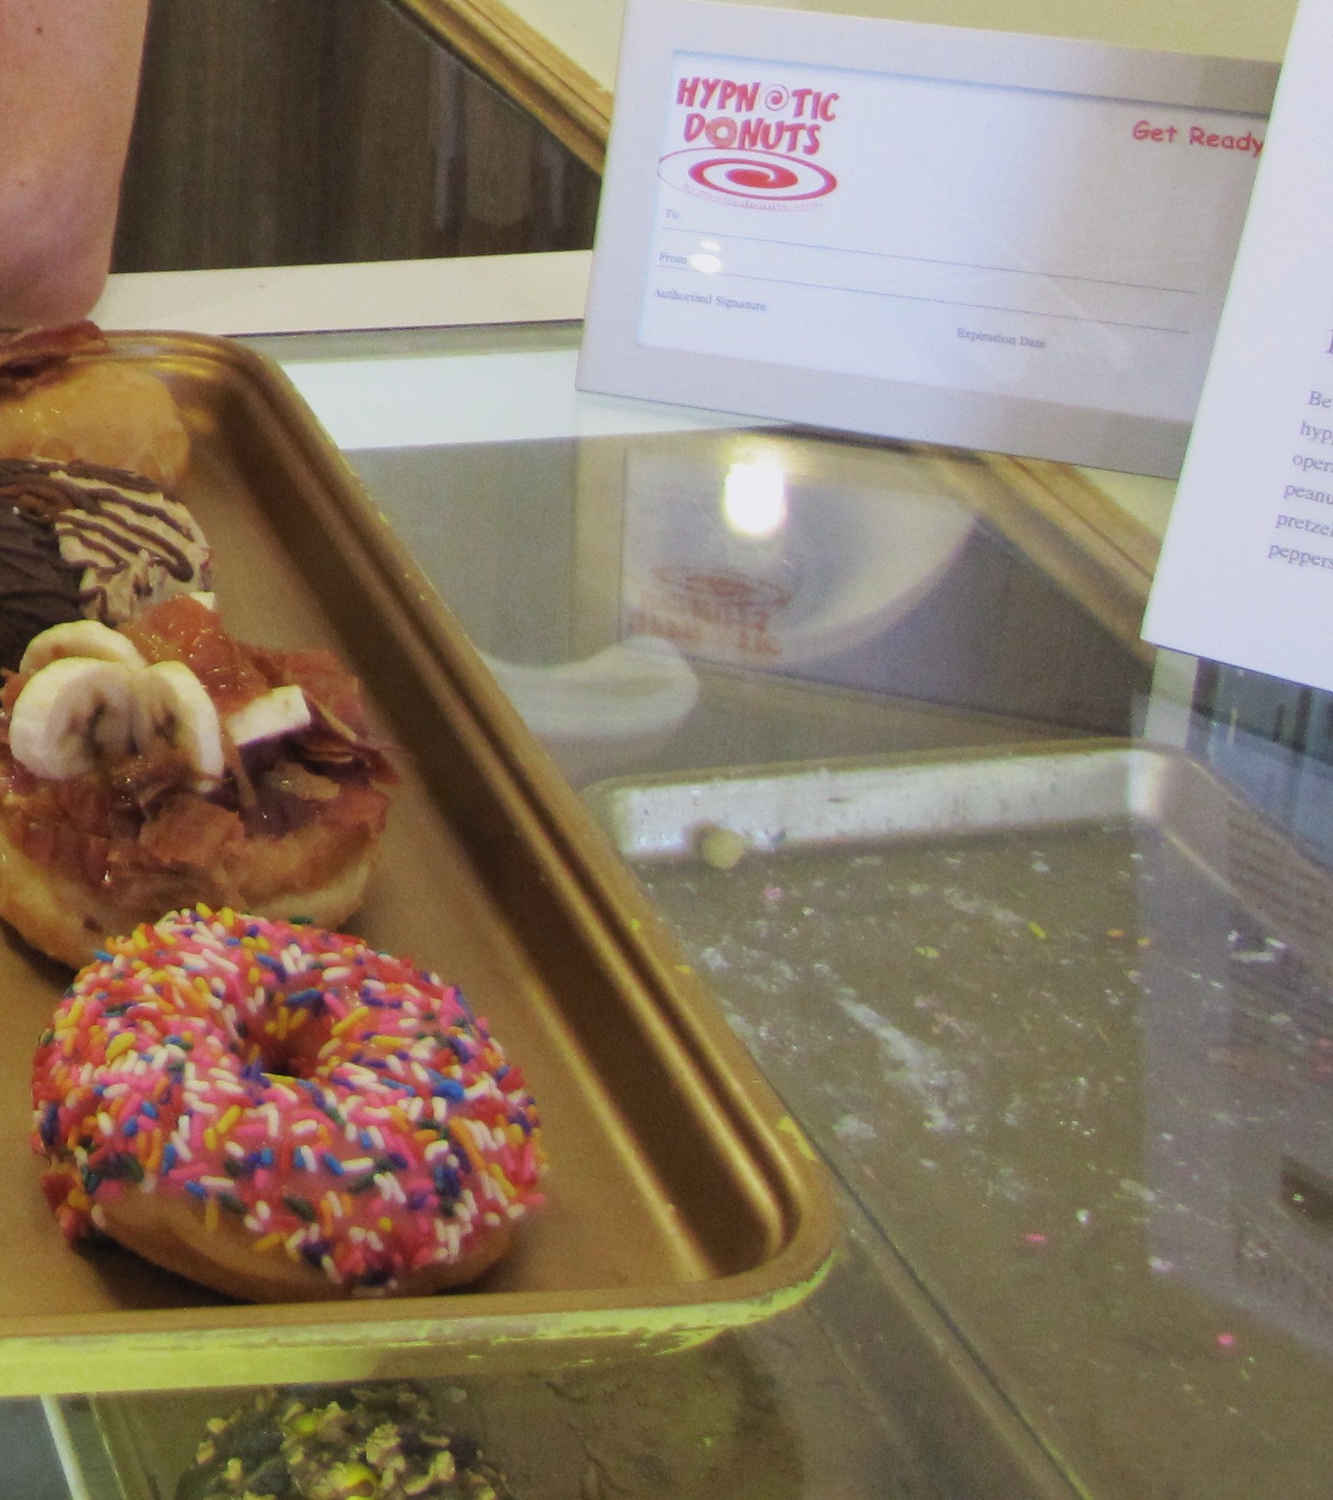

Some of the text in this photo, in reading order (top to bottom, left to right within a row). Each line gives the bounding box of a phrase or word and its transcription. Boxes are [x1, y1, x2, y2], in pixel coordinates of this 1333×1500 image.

[676, 76, 839, 122] HYPNOTIC
[683, 112, 822, 155] DONUTS
[1132, 120, 1265, 158] Get Ready
[664, 207, 680, 220] To
[658, 251, 687, 265] From
[654, 288, 767, 311] Authorized Signature
[956, 327, 1046, 350] Expiration Date
[1300, 418, 1333, 447] hyp
